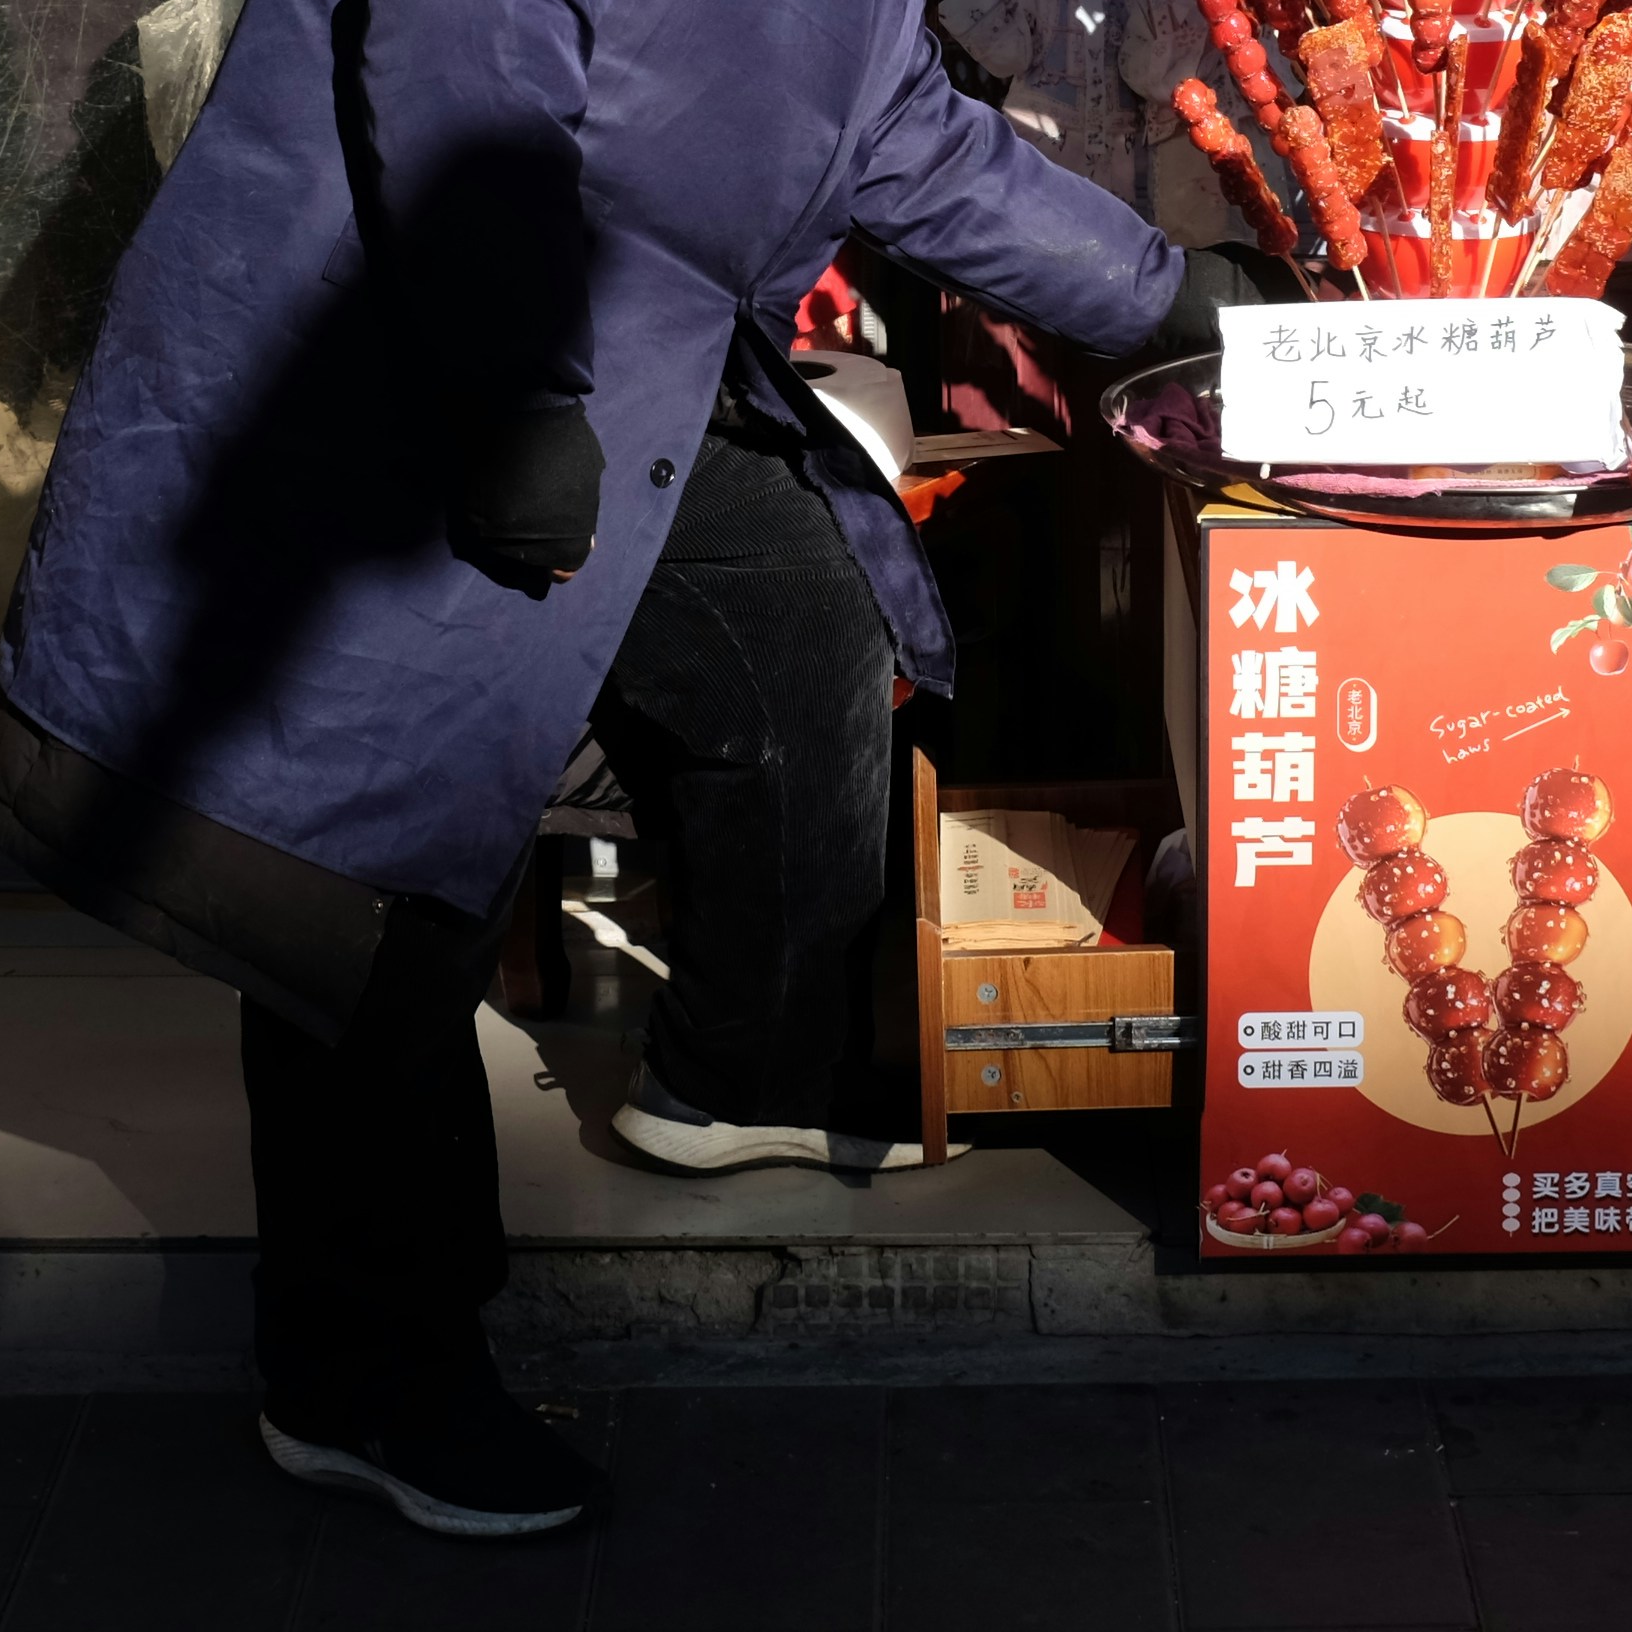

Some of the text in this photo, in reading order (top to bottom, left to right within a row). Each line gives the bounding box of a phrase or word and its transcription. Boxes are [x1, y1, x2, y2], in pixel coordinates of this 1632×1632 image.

[1262, 313, 1558, 363] 老北京冰糖葫芦
[1304, 380, 1437, 436] 5元起
[1228, 561, 1321, 887] 冰糖葫芦
[1347, 689, 1364, 736] 老北京
[1429, 685, 1570, 739] Sugar-coated
[1442, 738, 1490, 764] haws
[1260, 1020, 1356, 1041] 酸甜可口
[1261, 1059, 1359, 1080] 甜香四溢
